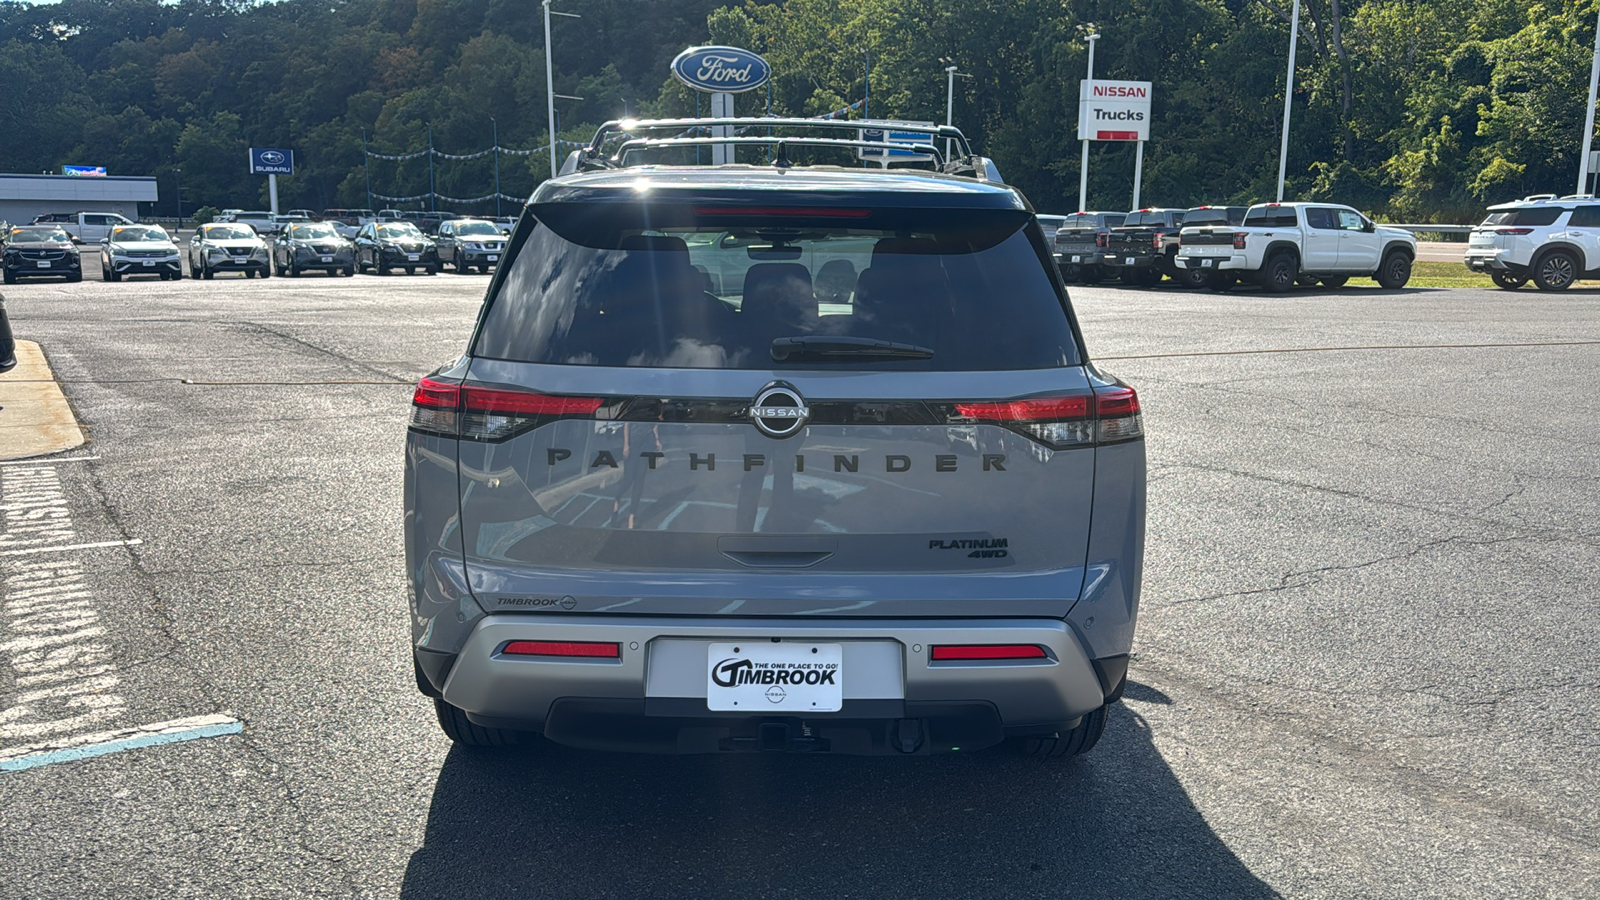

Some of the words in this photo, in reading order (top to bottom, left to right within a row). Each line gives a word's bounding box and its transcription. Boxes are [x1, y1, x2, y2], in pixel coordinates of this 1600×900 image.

[697, 55, 752, 82] Ford
[1093, 86, 1146, 97] NISSAN
[1093, 108, 1144, 121] Trucks
[751, 408, 808, 417] NISSAN
[547, 448, 1008, 473] PATHFINDER
[929, 538, 1008, 549] PLATINUM
[967, 549, 1008, 558] 4WD
[497, 597, 559, 606] TIMBROOK
[712, 658, 838, 687] TIMBROOK
